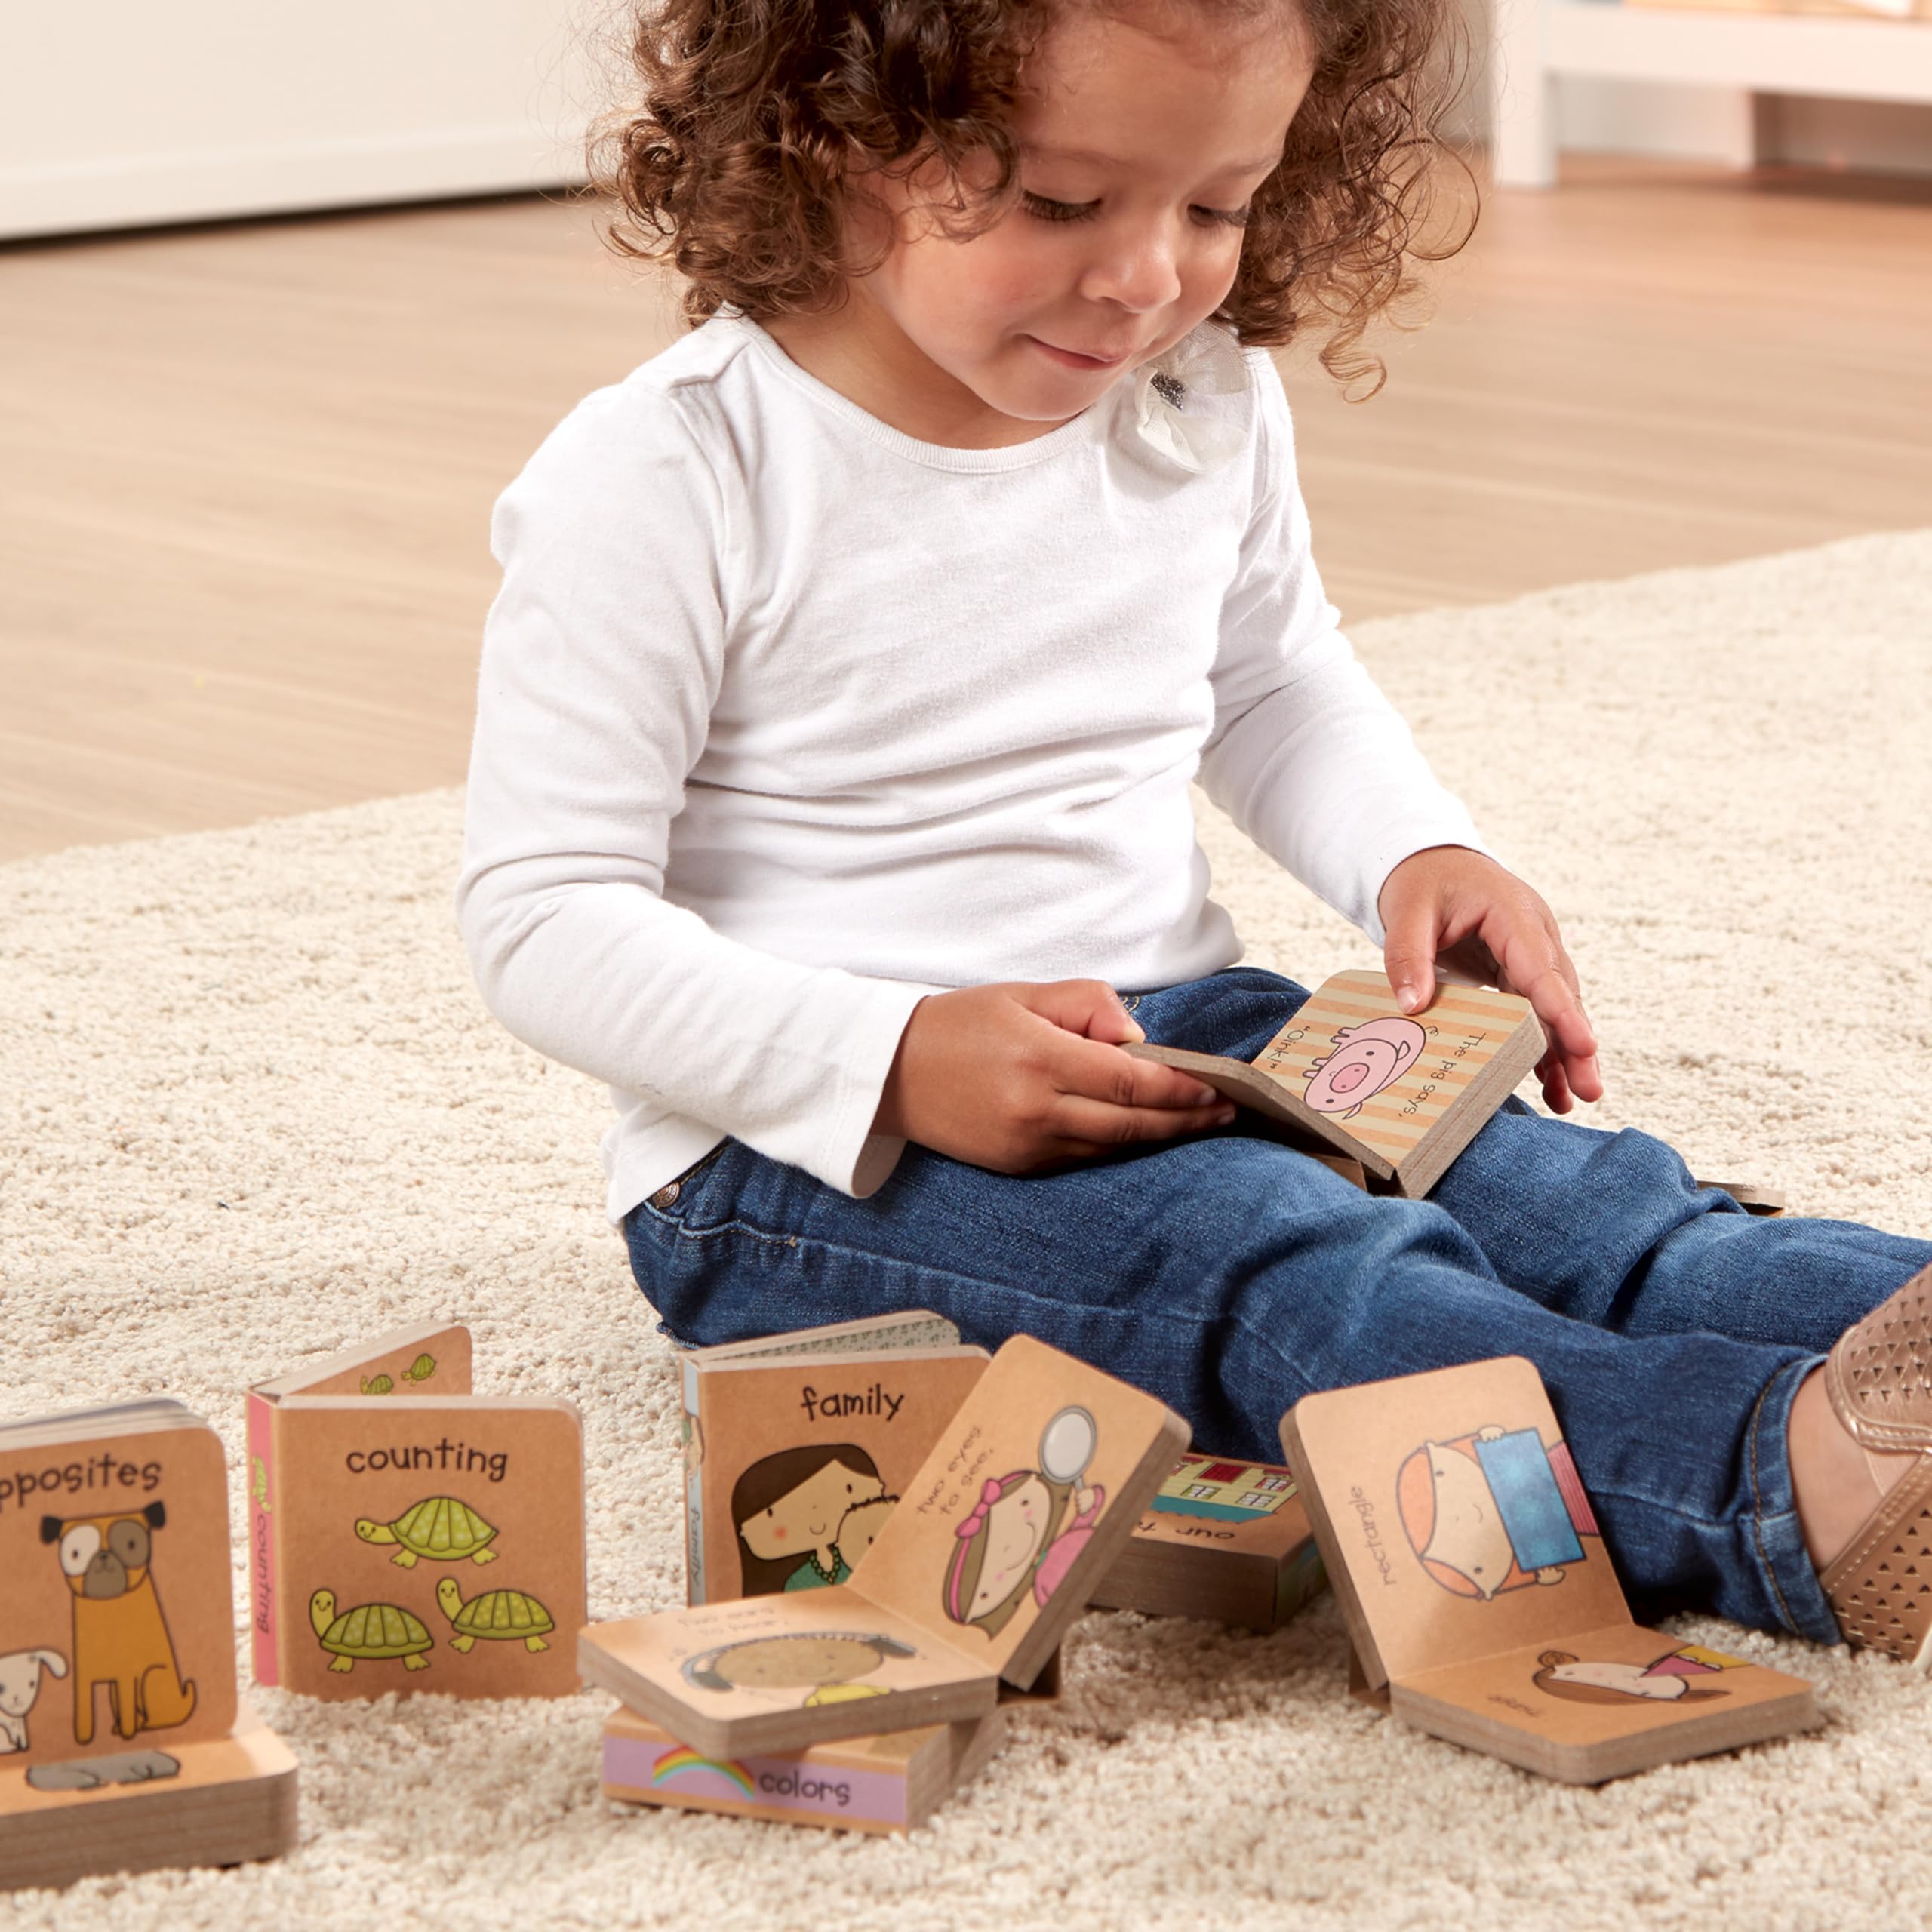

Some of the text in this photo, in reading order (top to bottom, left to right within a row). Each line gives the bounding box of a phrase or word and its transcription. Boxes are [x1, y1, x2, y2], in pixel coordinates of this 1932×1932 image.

[1398, 1032, 1487, 1117] The pig says,
[800, 1383, 905, 1422] family
[346, 1437, 508, 1483] counting
[1348, 1485, 1398, 1586] rectangle
[257, 1513, 272, 1635] counting
[758, 1770, 851, 1807] colors
